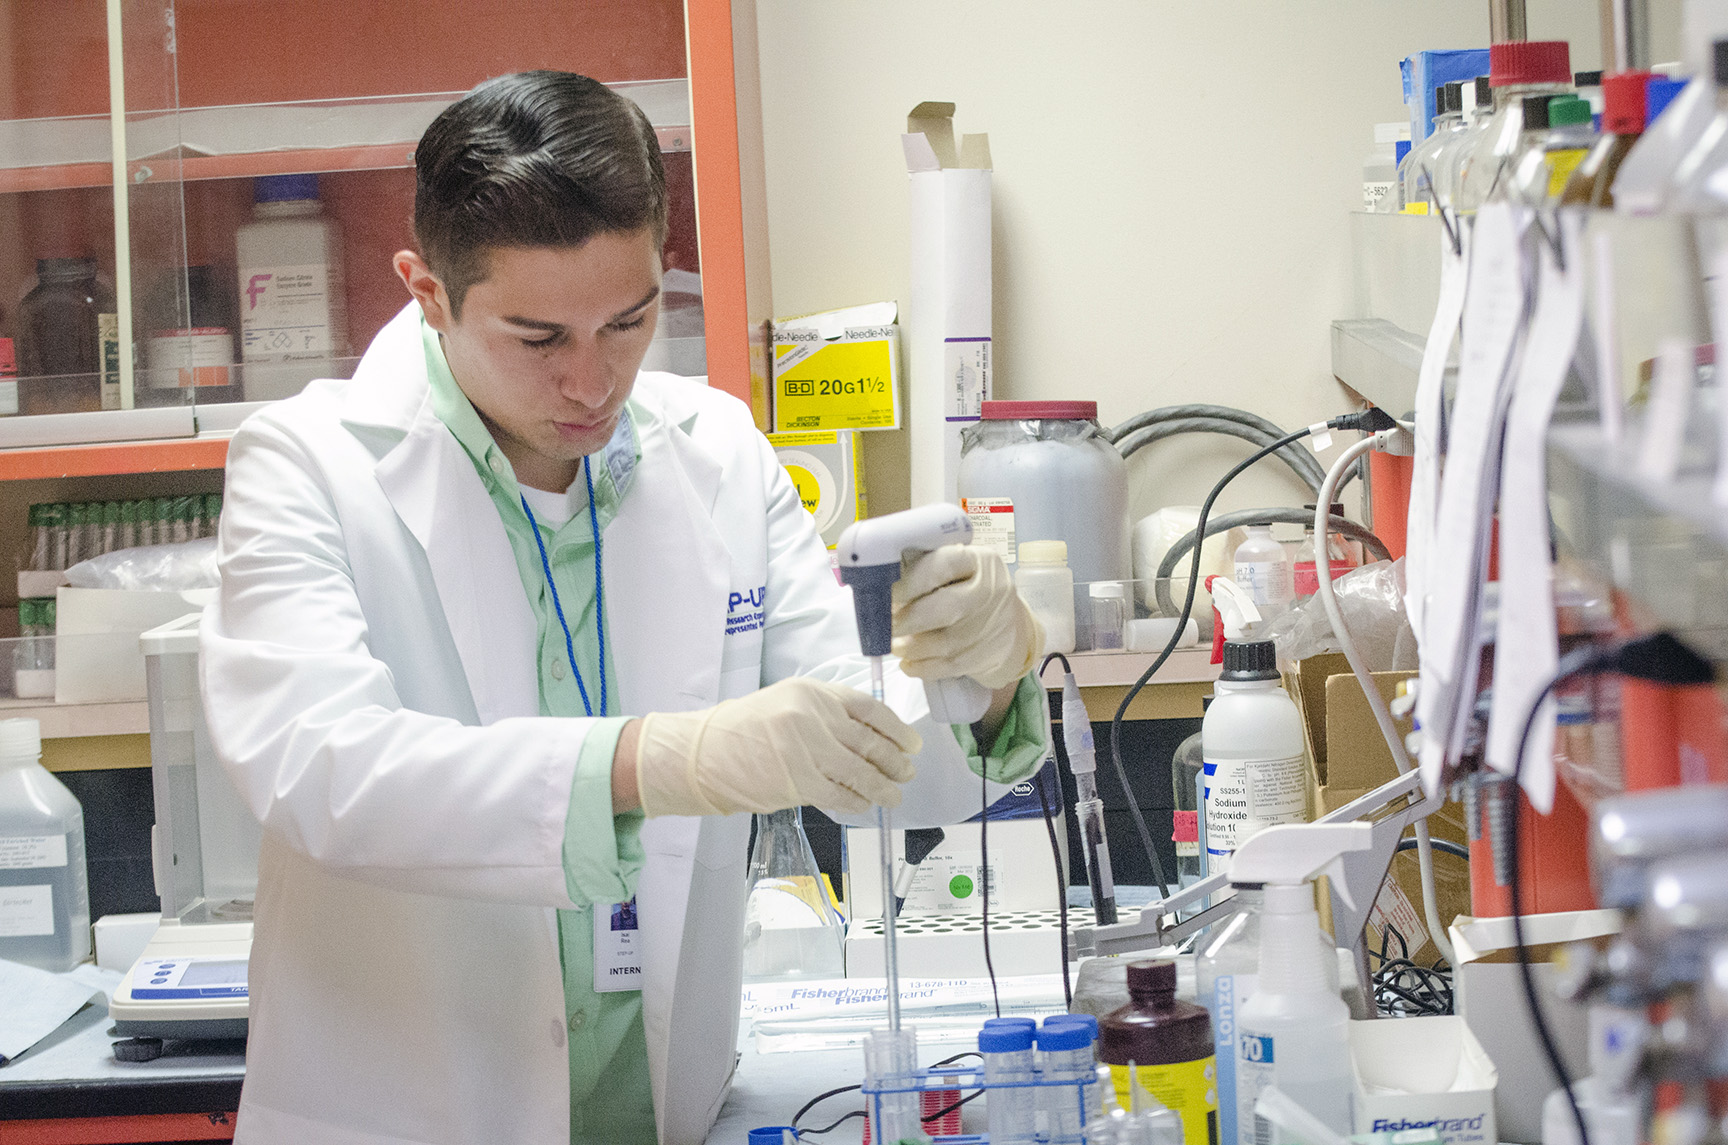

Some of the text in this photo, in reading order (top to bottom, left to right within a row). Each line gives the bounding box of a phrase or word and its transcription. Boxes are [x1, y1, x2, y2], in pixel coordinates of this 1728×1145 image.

[1214, 798, 1247, 807] Sodium
[1209, 810, 1248, 820] Hydroxide
[610, 966, 642, 976] INTERN
[910, 980, 968, 988] 13-678-11D
[835, 990, 935, 1005] Fisherrand
